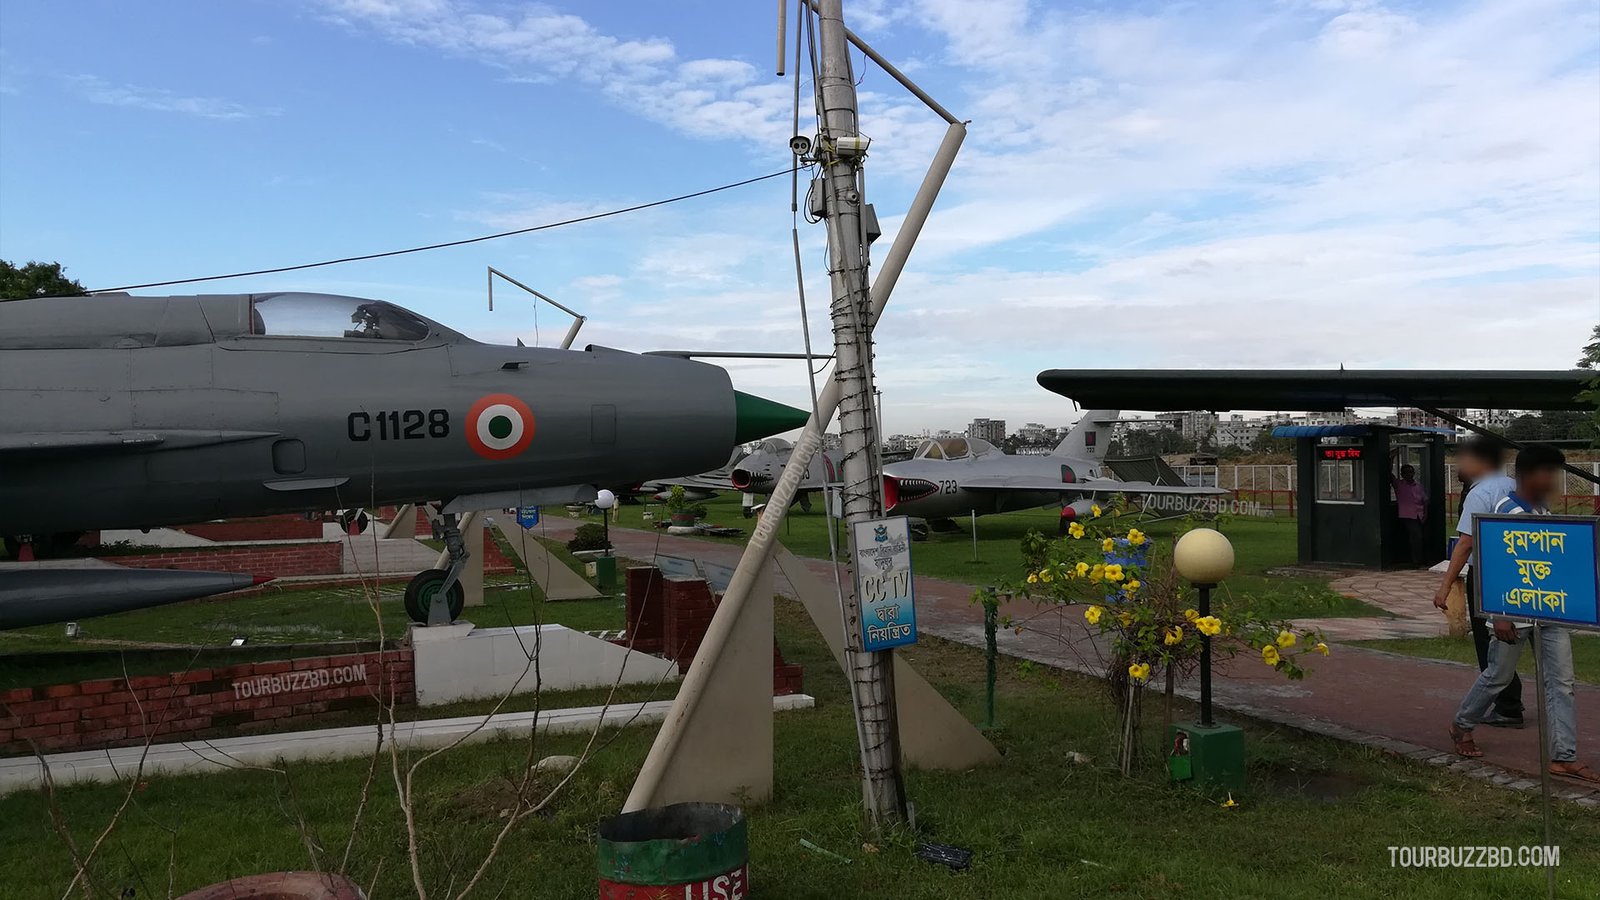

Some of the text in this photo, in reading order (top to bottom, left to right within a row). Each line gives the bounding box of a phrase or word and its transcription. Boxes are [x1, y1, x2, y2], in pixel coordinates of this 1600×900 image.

[347, 409, 450, 441] C1128
[939, 480, 957, 495] 723
[1515, 559, 1552, 587] মুক্ত
[875, 604, 900, 622] দ্বারা
[1505, 587, 1568, 614] এলাকা
